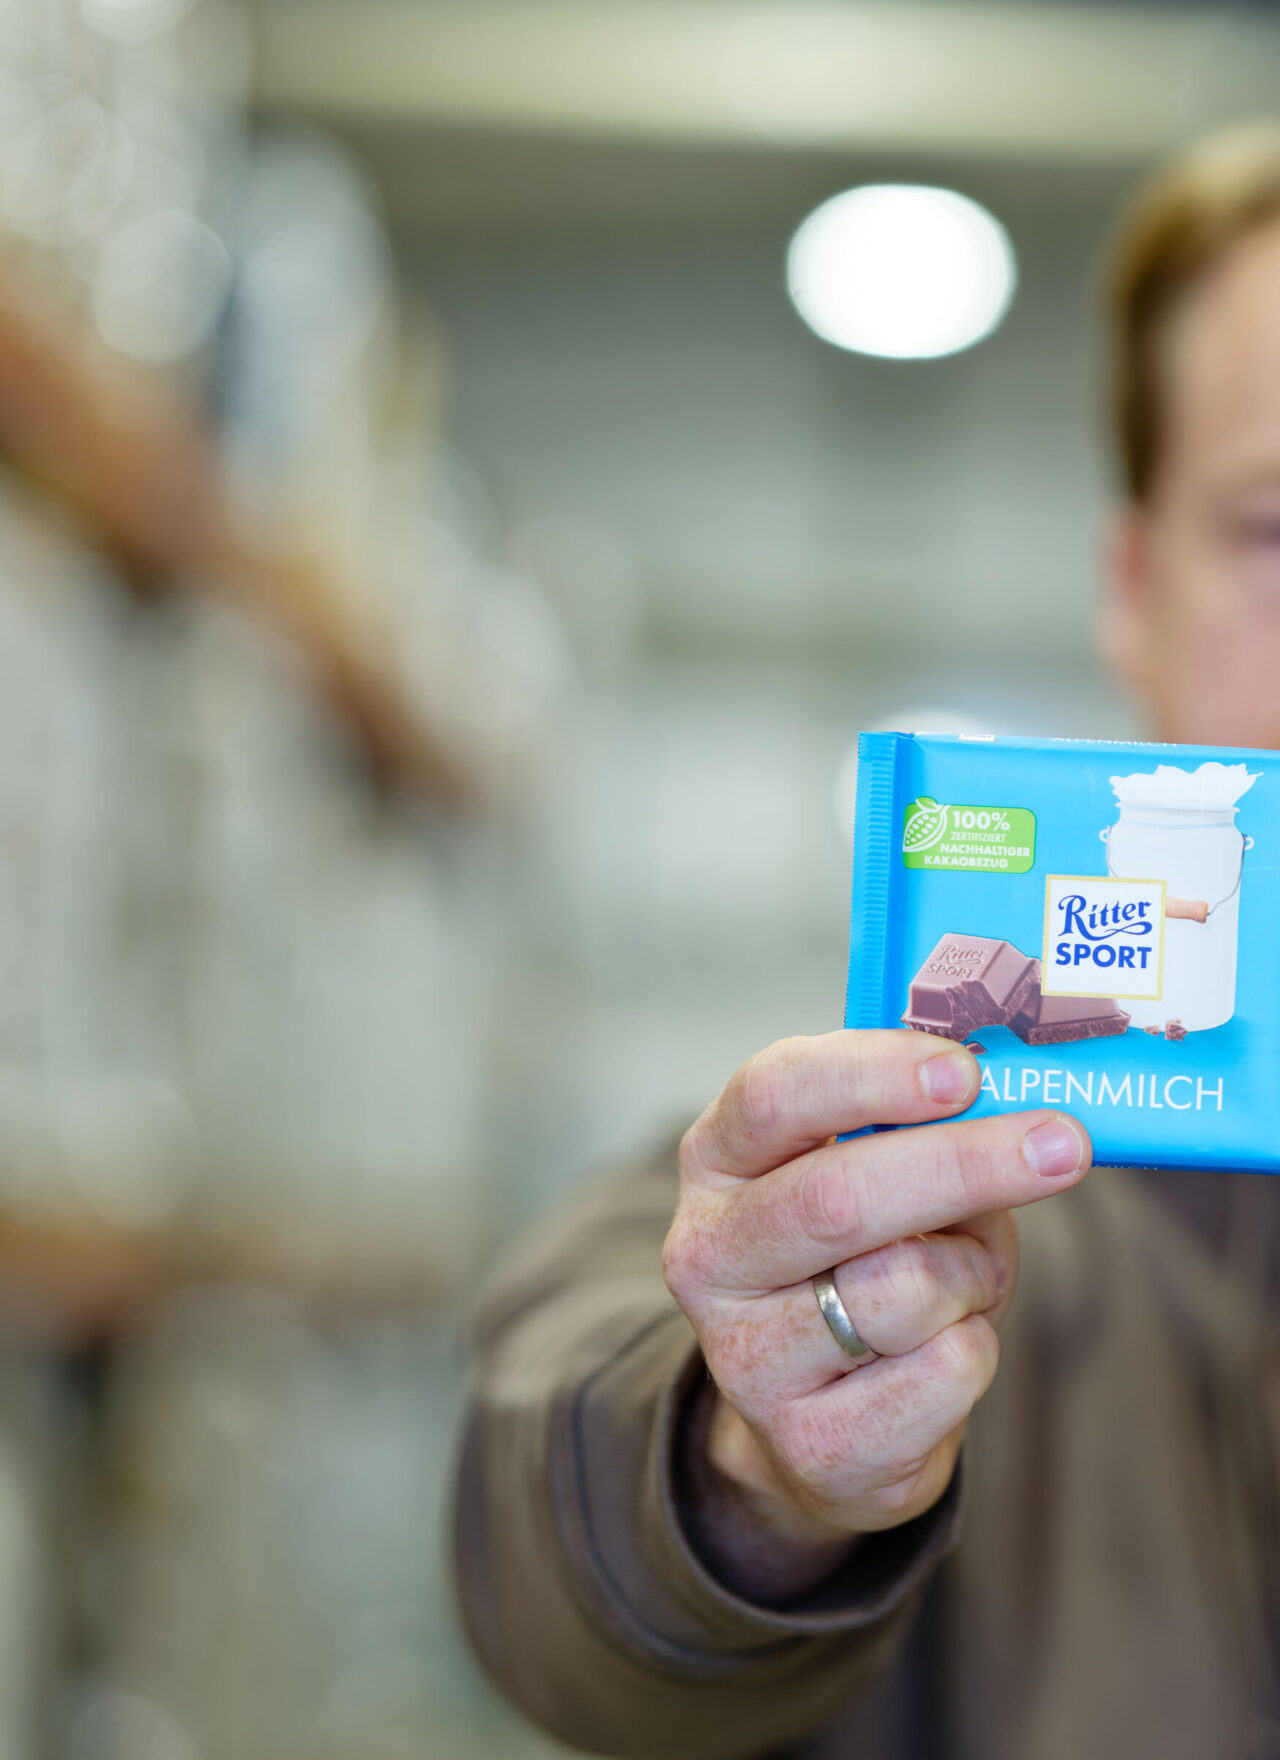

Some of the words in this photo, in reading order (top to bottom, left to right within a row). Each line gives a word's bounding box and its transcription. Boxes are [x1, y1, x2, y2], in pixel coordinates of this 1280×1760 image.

[951, 810, 1010, 831] 100%
[950, 831, 1007, 843] ZERTIFIZIERT
[940, 843, 1031, 857] NACHHALTIGER
[924, 855, 1009, 869] KAKAOBEZUG
[1057, 894, 1153, 941] Ritter
[1055, 942, 1152, 969] SPORT
[980, 1066, 1224, 1112] ALPENMILCH
